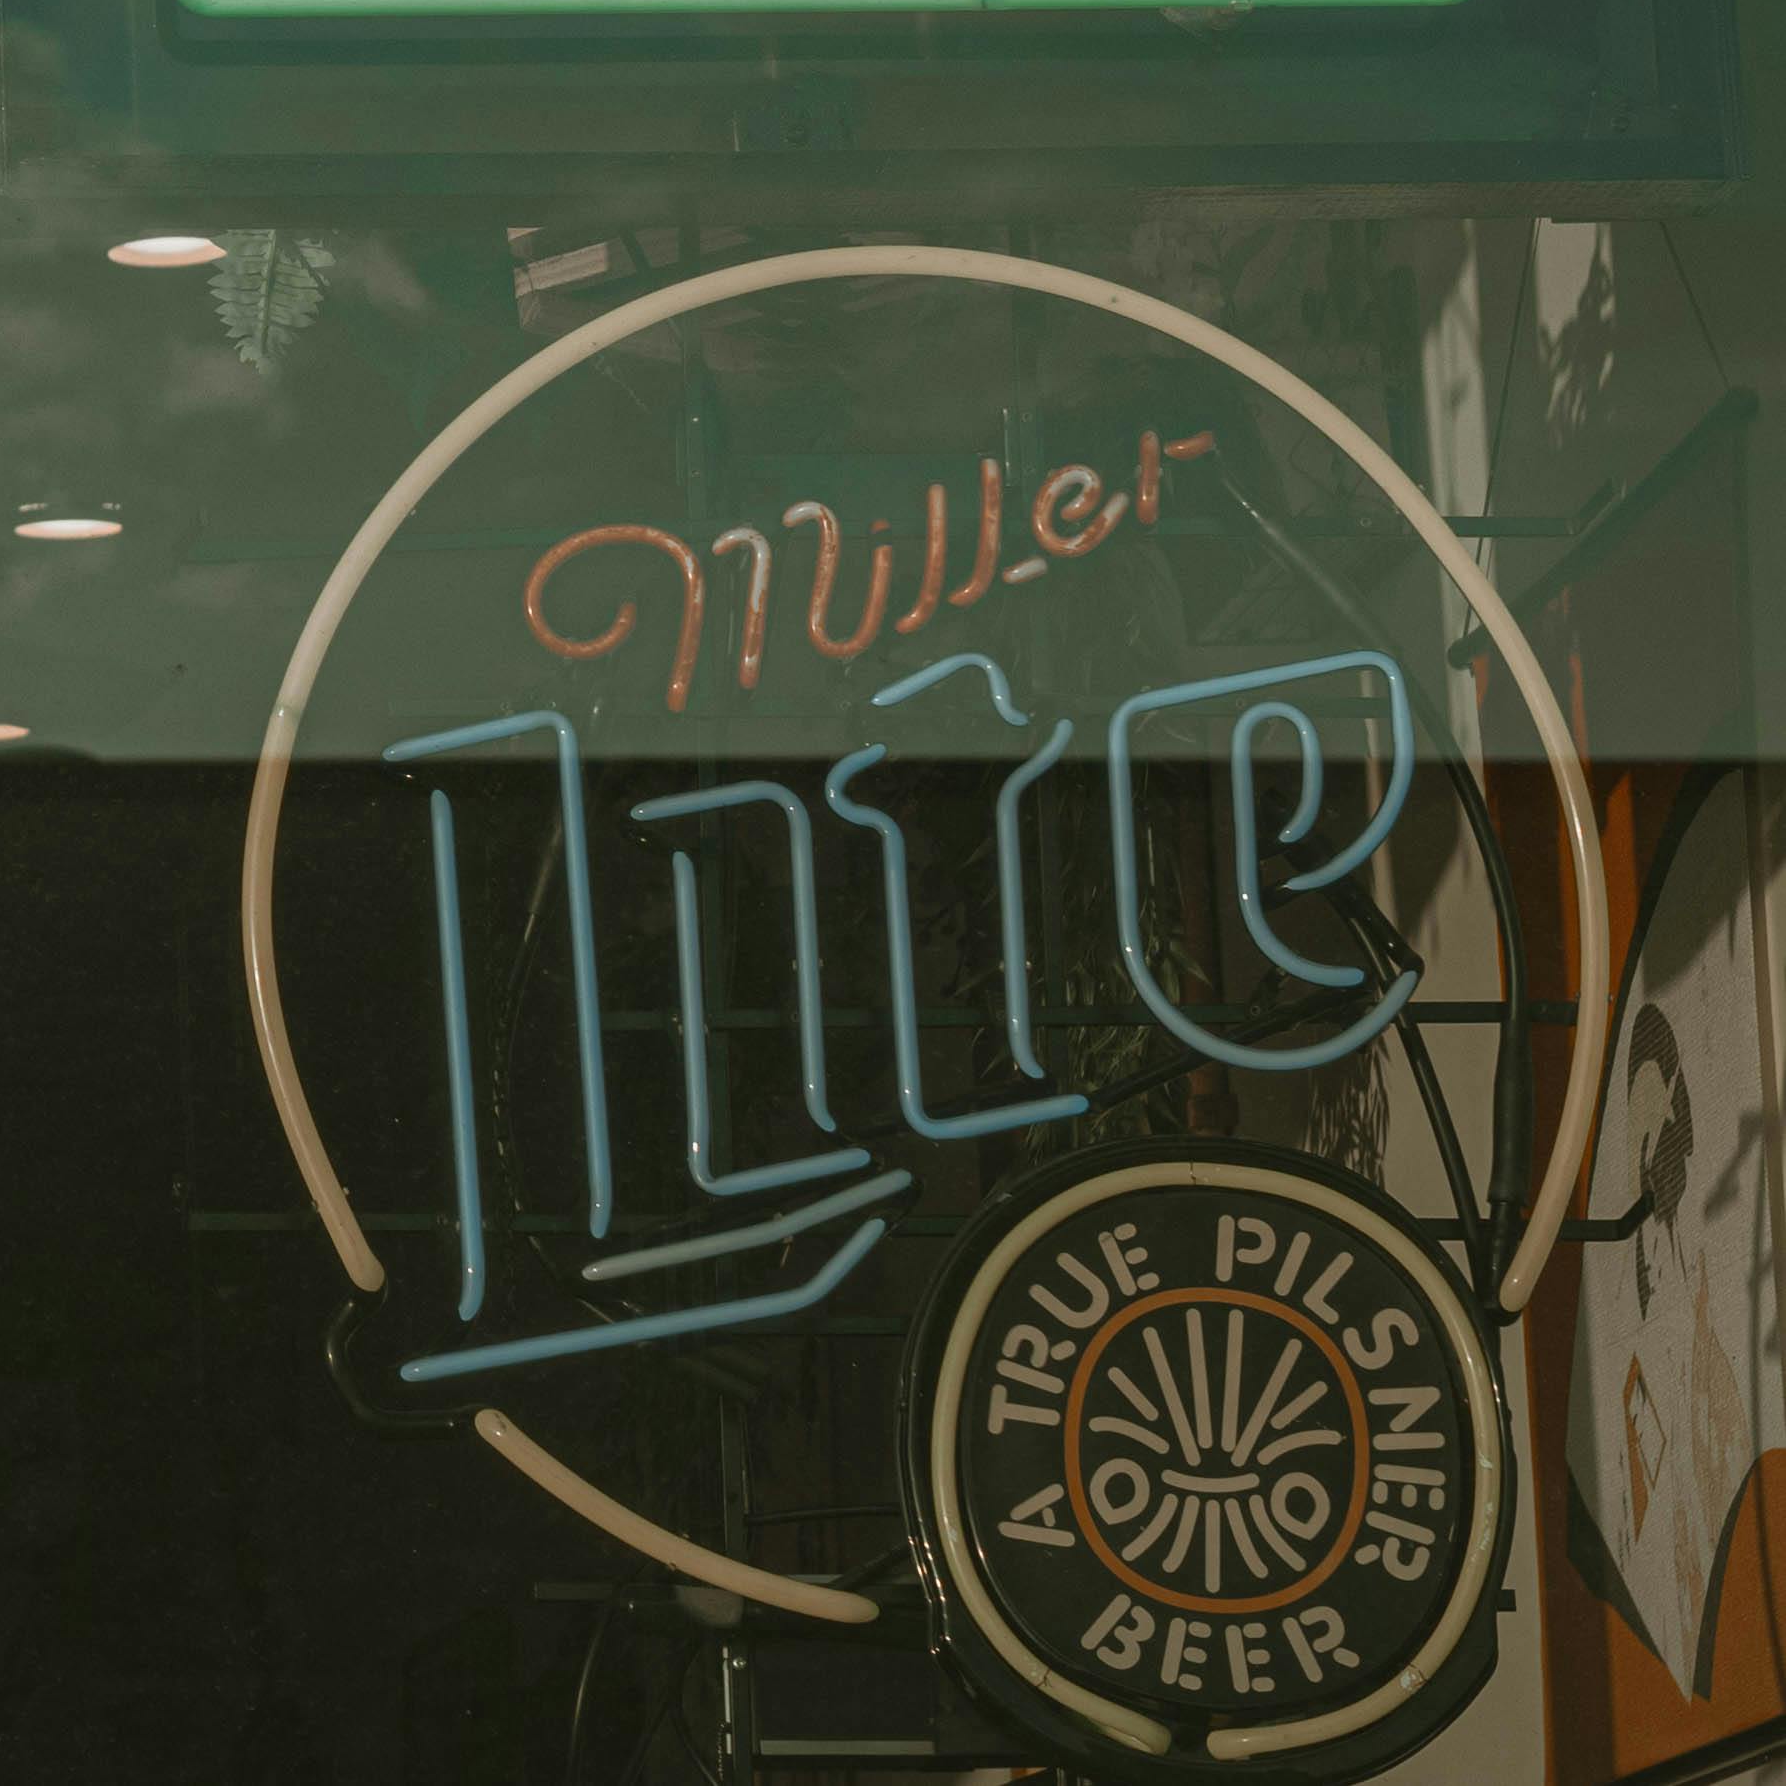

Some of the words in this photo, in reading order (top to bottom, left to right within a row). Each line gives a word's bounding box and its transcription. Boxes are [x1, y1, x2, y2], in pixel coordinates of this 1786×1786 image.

[523, 430, 1216, 711] Miller
[383, 650, 1415, 1385] Lite
[987, 1223, 1159, 1434] TRUE
[1216, 1215, 1446, 1581] PILSNER
[998, 1483, 1076, 1547] A
[1080, 1593, 1360, 1693] BEER
